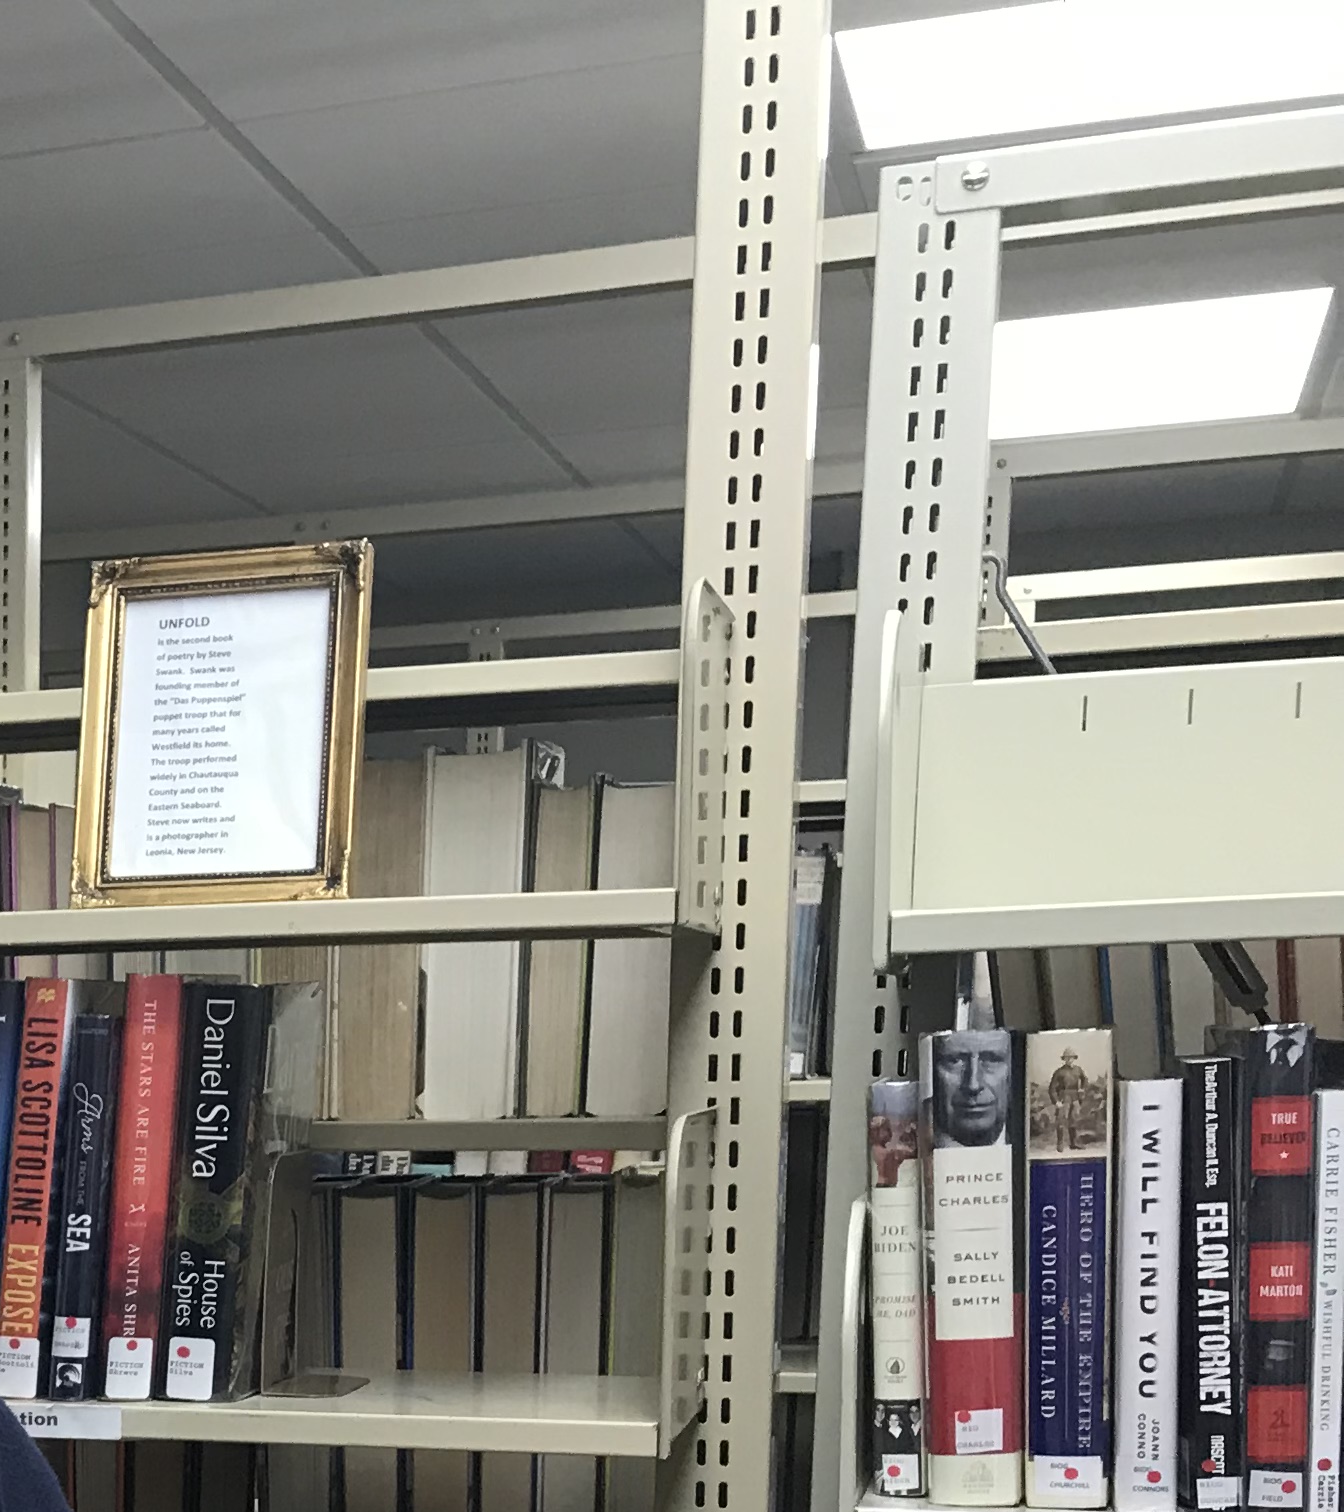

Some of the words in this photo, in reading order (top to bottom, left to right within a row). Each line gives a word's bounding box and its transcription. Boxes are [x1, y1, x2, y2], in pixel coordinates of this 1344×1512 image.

[159, 616, 210, 629] UNFOLD
[152, 728, 175, 736] many
[177, 727, 199, 736] years
[201, 725, 225, 733] called
[153, 712, 182, 722] puppet
[185, 711, 207, 720] troop
[210, 710, 227, 718] that
[152, 742, 191, 751] Westfield
[205, 740, 231, 748] home.
[168, 758, 191, 767] troop
[192, 754, 237, 765] performed
[149, 788, 178, 797] County
[150, 773, 177, 782] widely
[189, 770, 239, 779] Chautauqua
[148, 803, 178, 812] Eastern
[181, 801, 222, 809] Seaboard.
[192, 816, 217, 824] writes
[145, 848, 175, 857] Leonia,
[198, 846, 226, 855] Jersey.
[161, 831, 219, 842] photographer
[142, 1000, 158, 1036] THE
[25, 1016, 59, 1070] LISA
[200, 998, 235, 1096] Daniel
[139, 1042, 155, 1098] STARS
[135, 1104, 150, 1139] ARE
[1270, 1113, 1297, 1124] TRUE
[10, 1079, 54, 1227] SCOTTOLINE
[192, 1103, 230, 1179] Silva
[132, 1147, 148, 1186] FIRE
[945, 1173, 1003, 1184] PRINCE
[1141, 1129, 1160, 1214] WILL
[1326, 1127, 1340, 1198] CARRIE
[938, 1195, 1009, 1207] CHARLES
[65, 1213, 92, 1253] SEA
[1323, 1207, 1338, 1276] FISHER
[124, 1243, 141, 1297] ANITA
[953, 1252, 999, 1262] SALLY
[1041, 1204, 1058, 1306] CANDICE
[1270, 1265, 1293, 1278] KATI
[947, 1274, 1005, 1285] BEDELL
[1140, 1231, 1159, 1315] FIND
[171, 1269, 200, 1328] Spies
[200, 1259, 226, 1330] House
[952, 1297, 1000, 1307] SMITH
[1260, 1285, 1303, 1297] MARTON
[1321, 1300, 1333, 1358] WISHFUL
[1040, 1316, 1057, 1419] MILLARD
[1138, 1331, 1158, 1399] YOU
[1319, 1365, 1332, 1432] DRINKING
